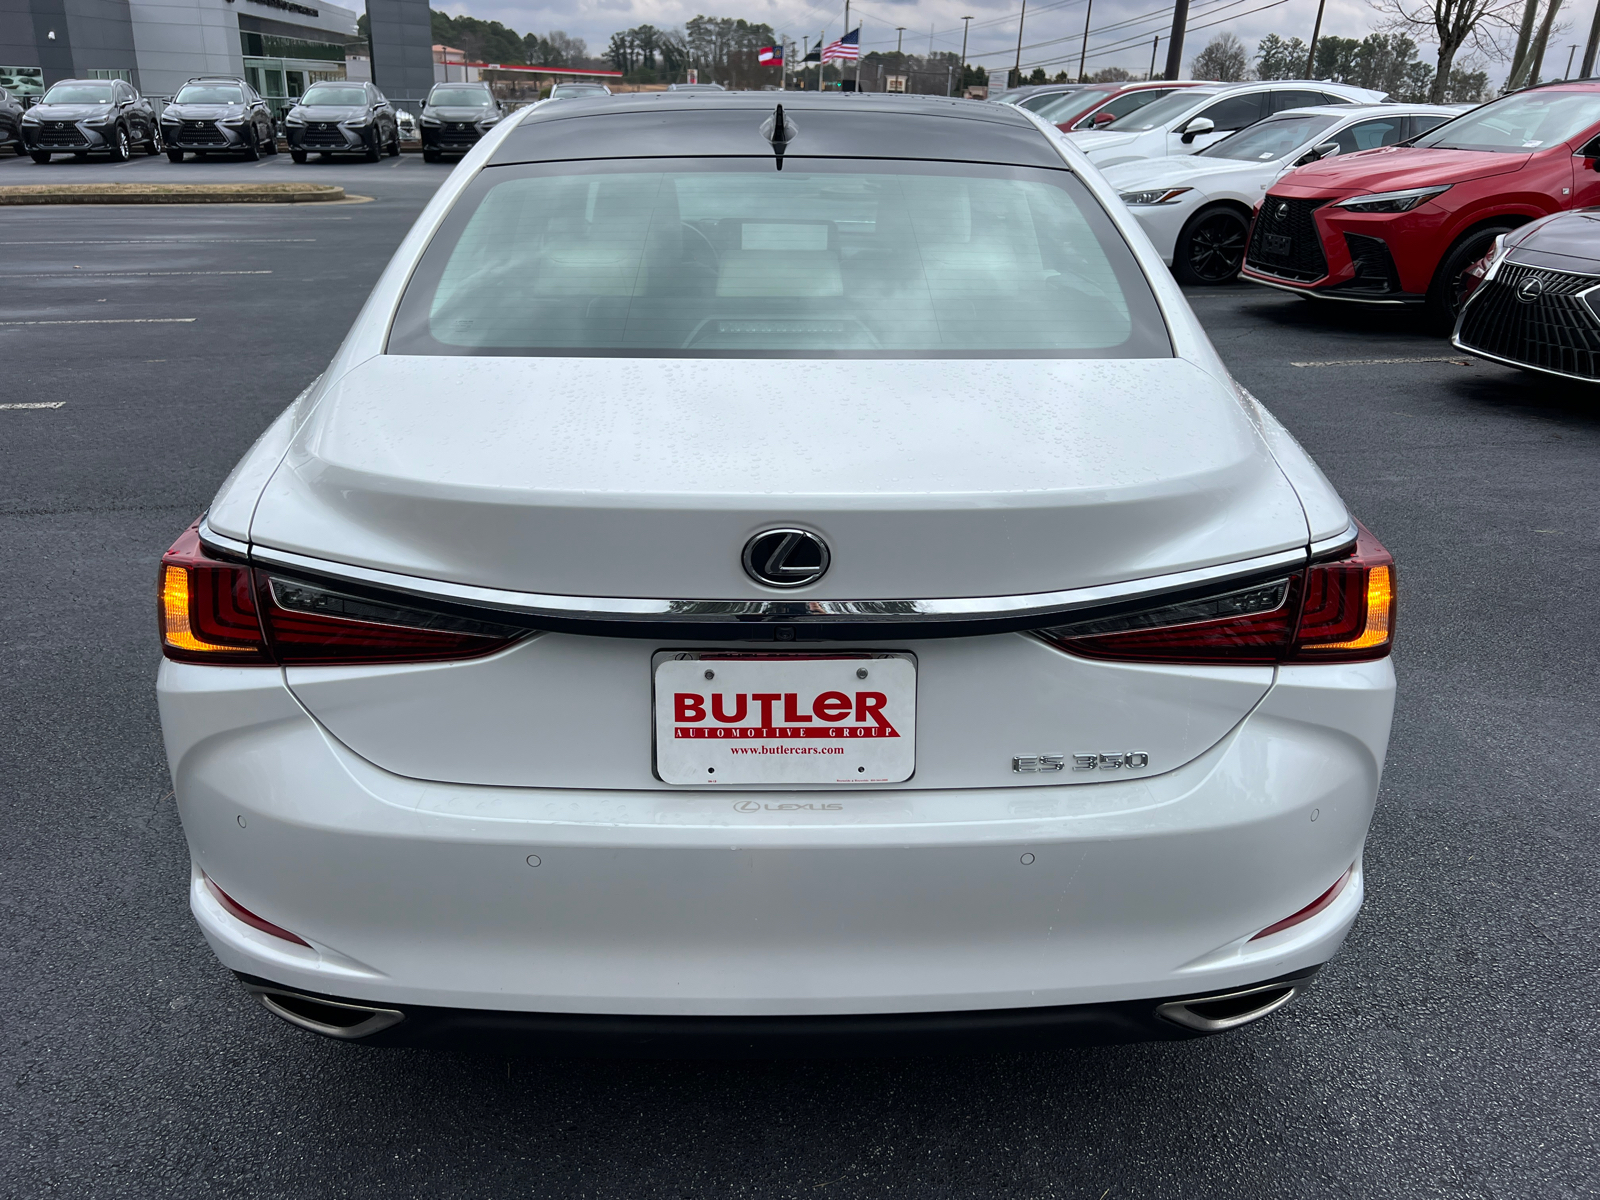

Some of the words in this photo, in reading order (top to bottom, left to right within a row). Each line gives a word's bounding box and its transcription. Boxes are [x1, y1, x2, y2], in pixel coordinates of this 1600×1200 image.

[675, 728, 806, 738] AUTOMOTIVE
[828, 727, 892, 737] GROUP
[730, 745, 844, 755] www.butlercars.com
[1011, 755, 1065, 774] ES
[1071, 751, 1149, 772] 350
[763, 803, 844, 811] LEXUS
